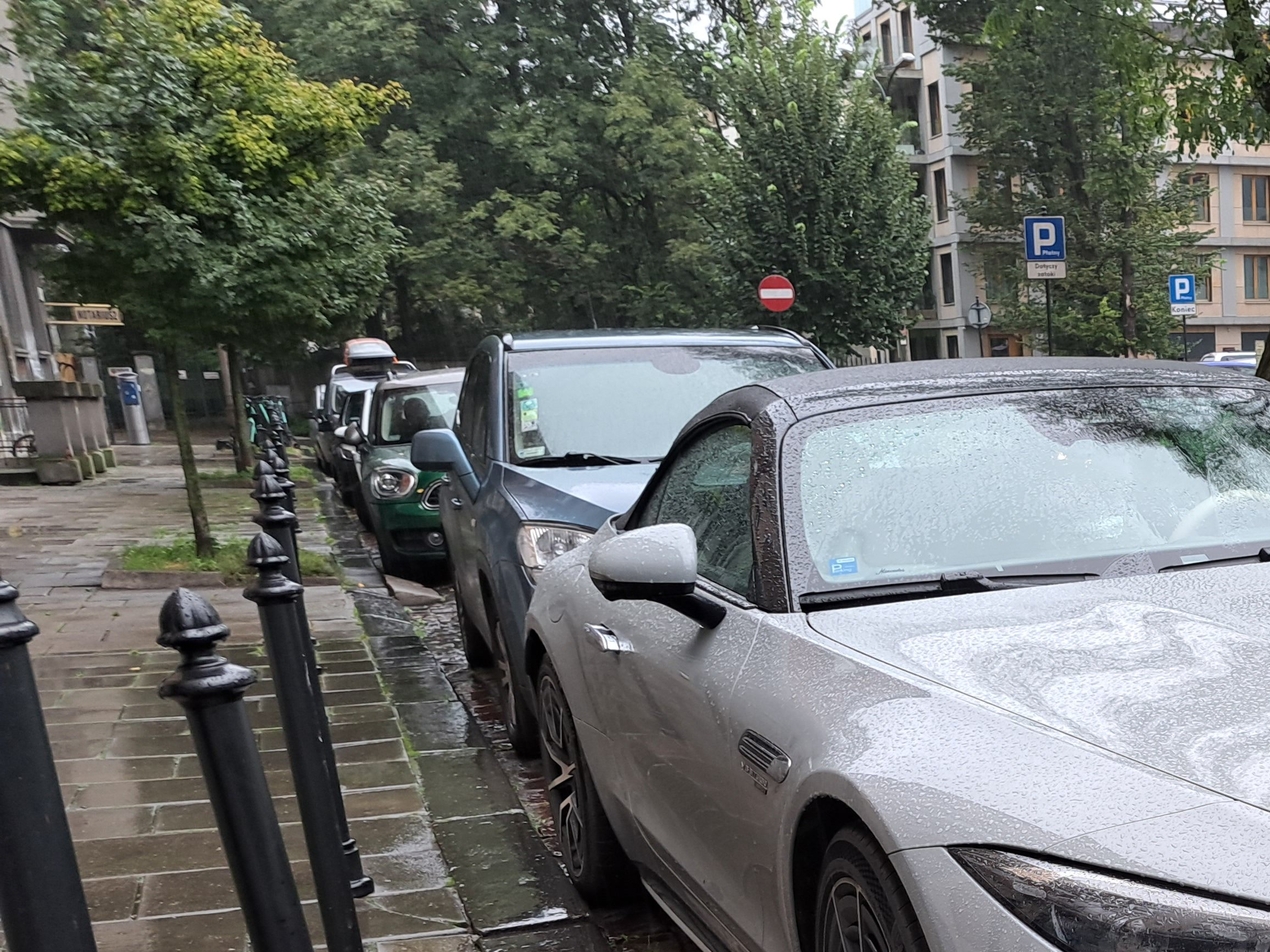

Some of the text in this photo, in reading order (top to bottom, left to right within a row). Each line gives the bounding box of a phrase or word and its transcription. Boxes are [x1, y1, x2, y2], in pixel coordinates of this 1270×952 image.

[1033, 222, 1056, 256] P
[1175, 277, 1190, 300] P
[1172, 305, 1196, 313] Koniec
